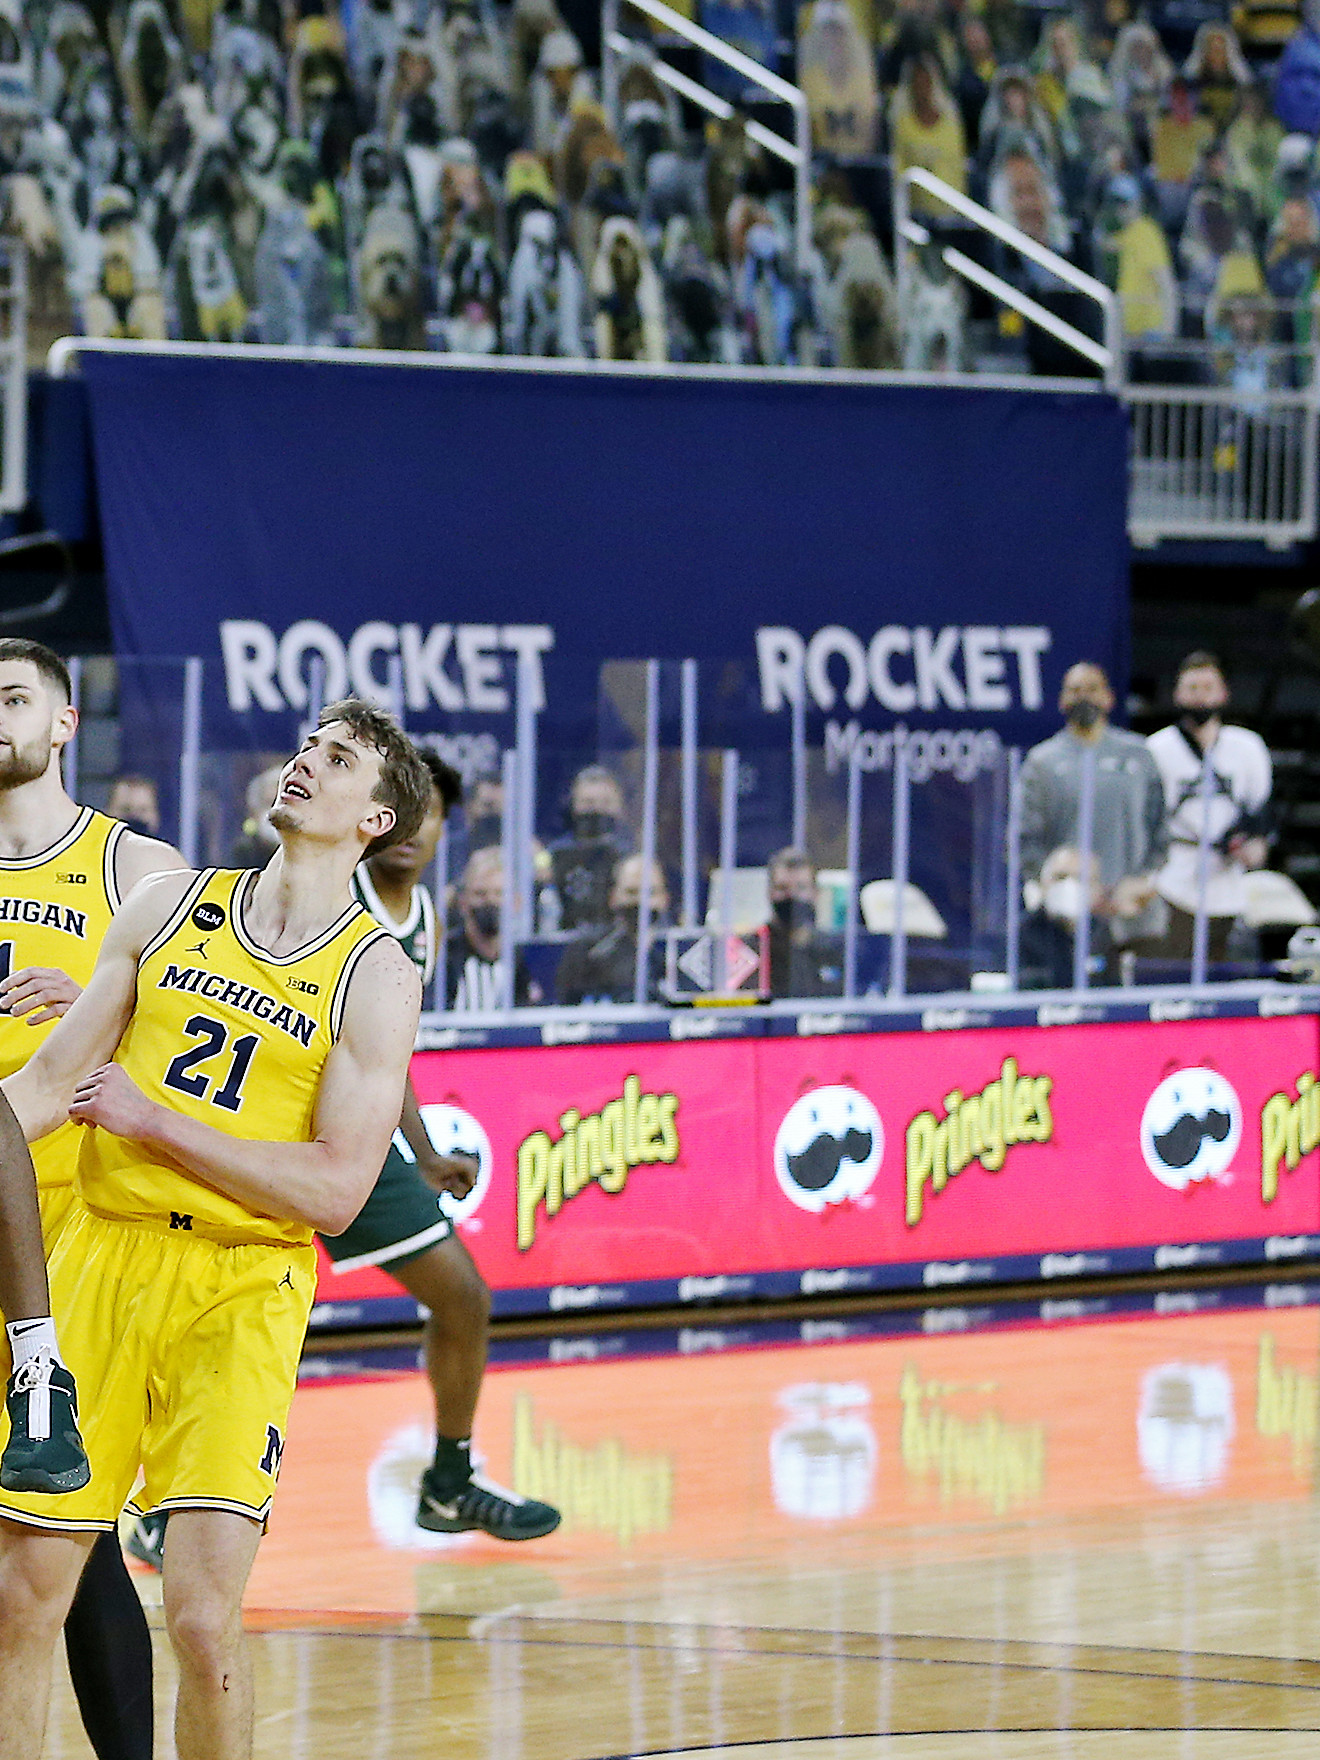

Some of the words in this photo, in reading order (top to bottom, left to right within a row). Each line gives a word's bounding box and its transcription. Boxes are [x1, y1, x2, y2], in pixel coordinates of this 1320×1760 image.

[218, 618, 556, 713] ROCKET
[754, 623, 1053, 714] ROCKET
[824, 718, 1003, 783] Mortgage
[196, 908, 222, 925] BLM
[159, 965, 318, 1049] MICHIGAN
[164, 1015, 262, 1113] 21
[515, 1072, 680, 1252] Pringles
[904, 1056, 1053, 1228] Pringles
[169, 1211, 194, 1231] M
